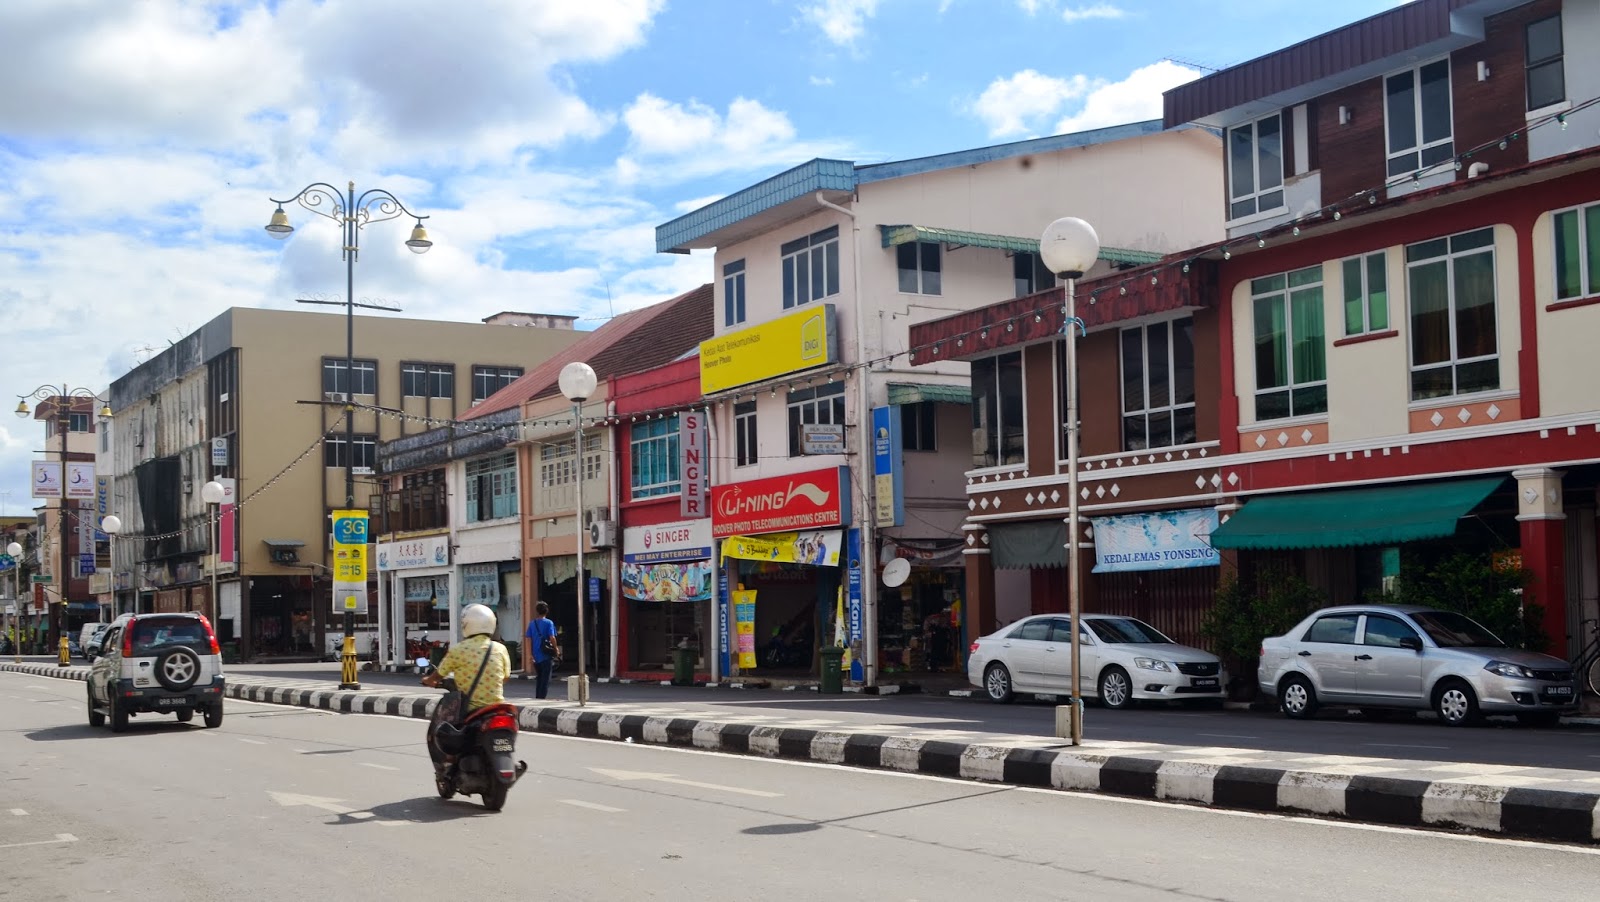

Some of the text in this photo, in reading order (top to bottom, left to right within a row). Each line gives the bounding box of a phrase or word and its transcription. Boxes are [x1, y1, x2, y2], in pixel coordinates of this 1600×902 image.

[720, 355, 731, 364] Photo
[686, 416, 699, 513] SINGER
[98, 479, 107, 514] GREE
[342, 519, 365, 535] 3G
[713, 510, 838, 535] HOOVER PHOTO TELECOMMUNICATIONS CENTRE
[656, 529, 691, 545] SINGER
[634, 549, 703, 562] MEI MAY ENTERPRISE
[1104, 547, 1213, 564] KEDAI EMAS YONSENG
[349, 564, 362, 576] 15
[720, 603, 728, 653] Konica
